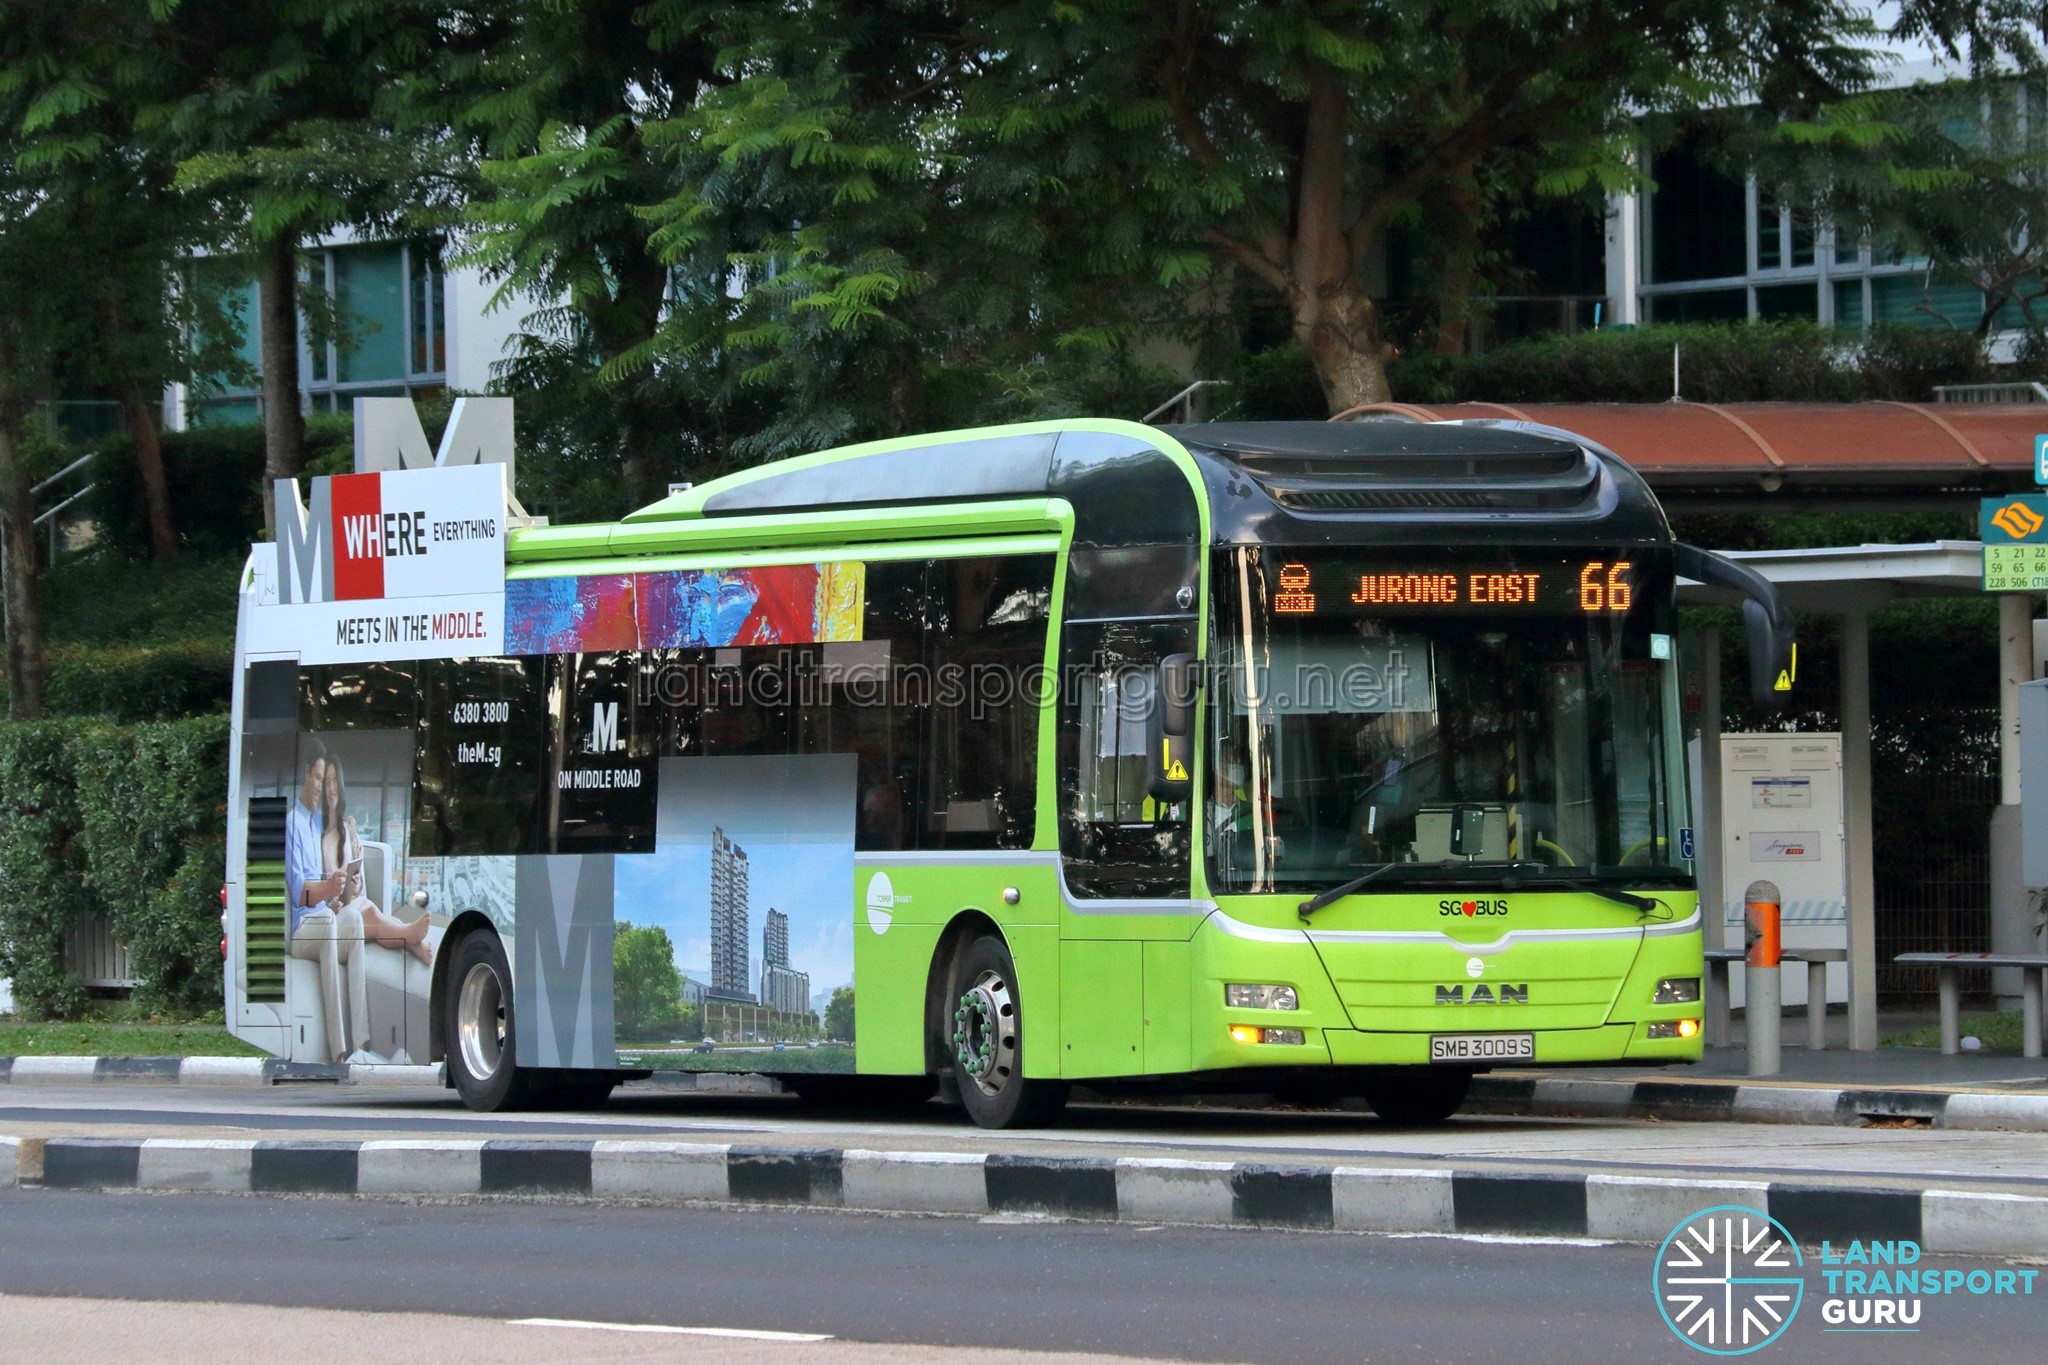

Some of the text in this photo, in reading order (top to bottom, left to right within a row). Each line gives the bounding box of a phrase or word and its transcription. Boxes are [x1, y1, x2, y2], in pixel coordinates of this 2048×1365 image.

[274, 475, 335, 604] M
[343, 511, 496, 560] WHERE EVERYTHING
[1994, 548, 2046, 558] 5 21 22
[1991, 562, 2046, 573] 59 65 66
[1351, 562, 1631, 610] JURONG EAST 66
[1989, 578, 2006, 588] 228
[2011, 577, 2028, 587] 506
[336, 611, 487, 645] MEETS IN THE MIDDLE.
[453, 701, 510, 723] 6380 3800
[593, 702, 619, 752] M
[458, 742, 502, 767] theM.sg
[557, 769, 641, 789] ON MIDDLE ROAD
[1435, 984, 1528, 1005] MAN
